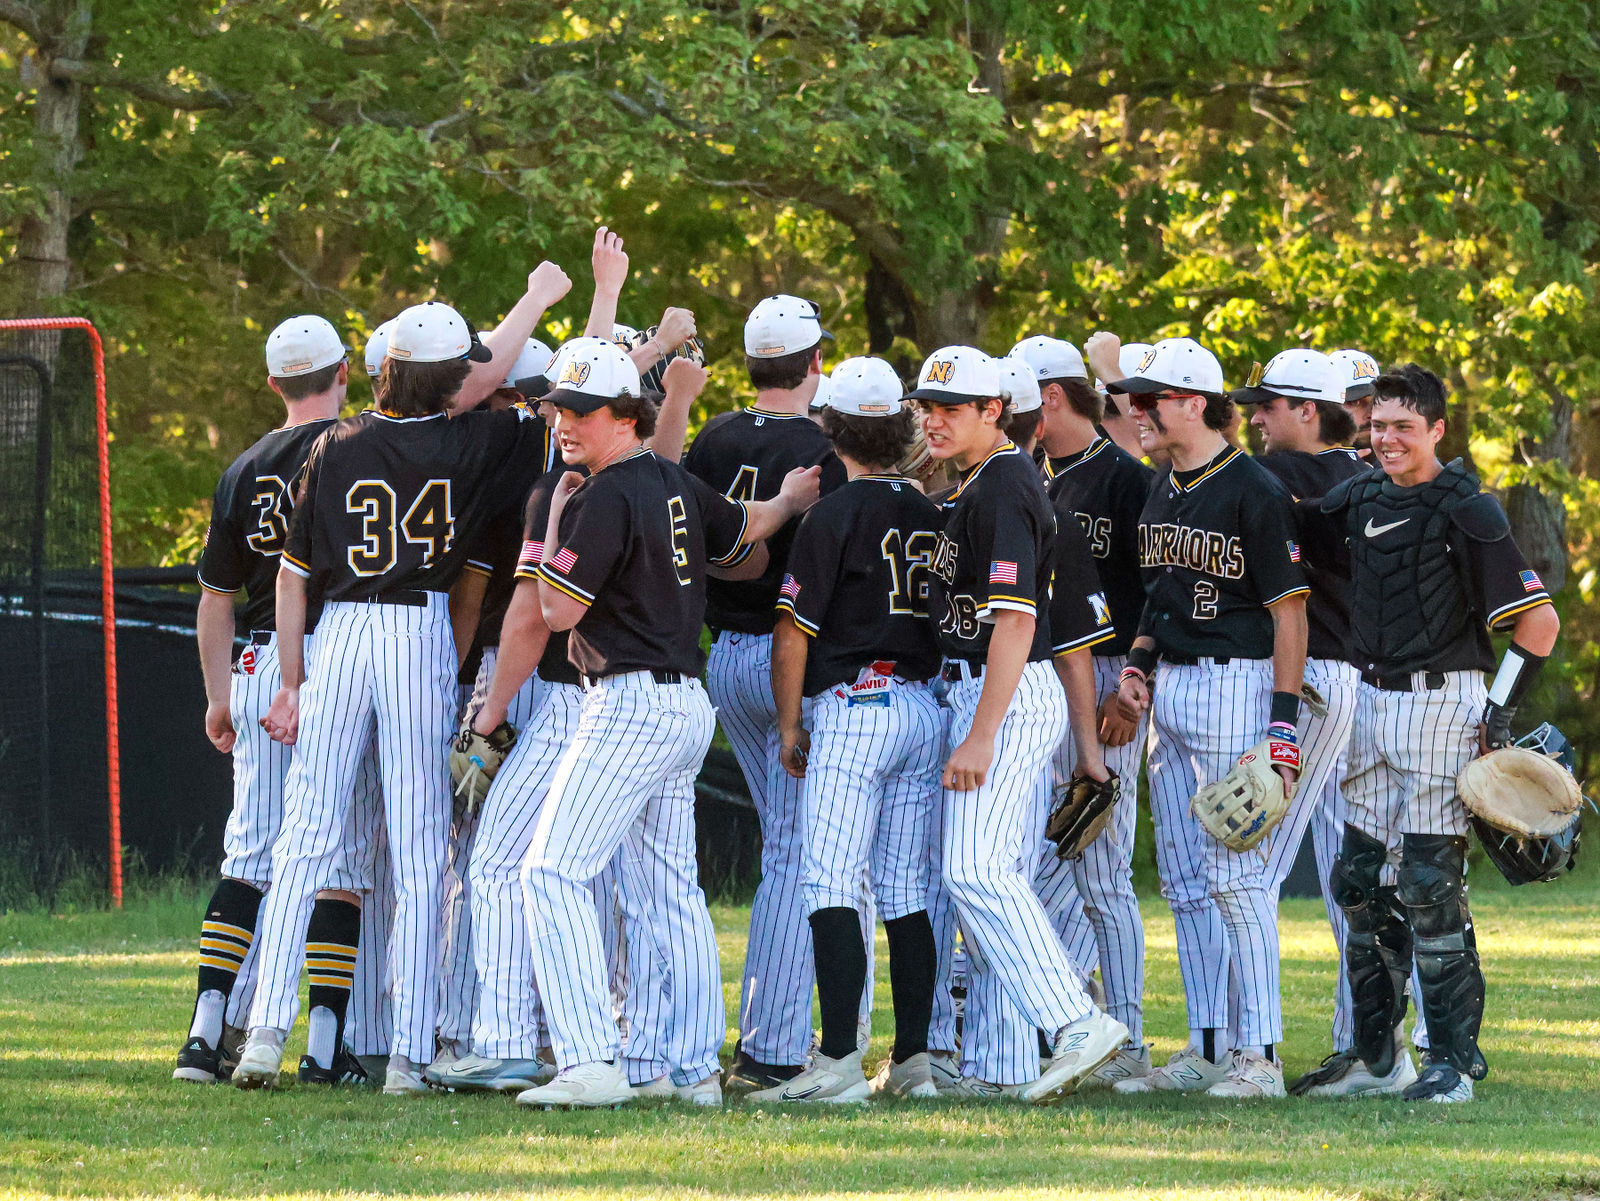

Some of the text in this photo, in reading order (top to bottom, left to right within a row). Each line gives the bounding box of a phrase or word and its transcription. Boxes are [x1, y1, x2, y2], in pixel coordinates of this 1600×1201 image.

[924, 361, 951, 384] N
[246, 475, 295, 557] 3
[346, 478, 455, 577] 34
[881, 528, 937, 617] 12
[1192, 580, 1218, 619] 2
[1087, 591, 1112, 626] N
